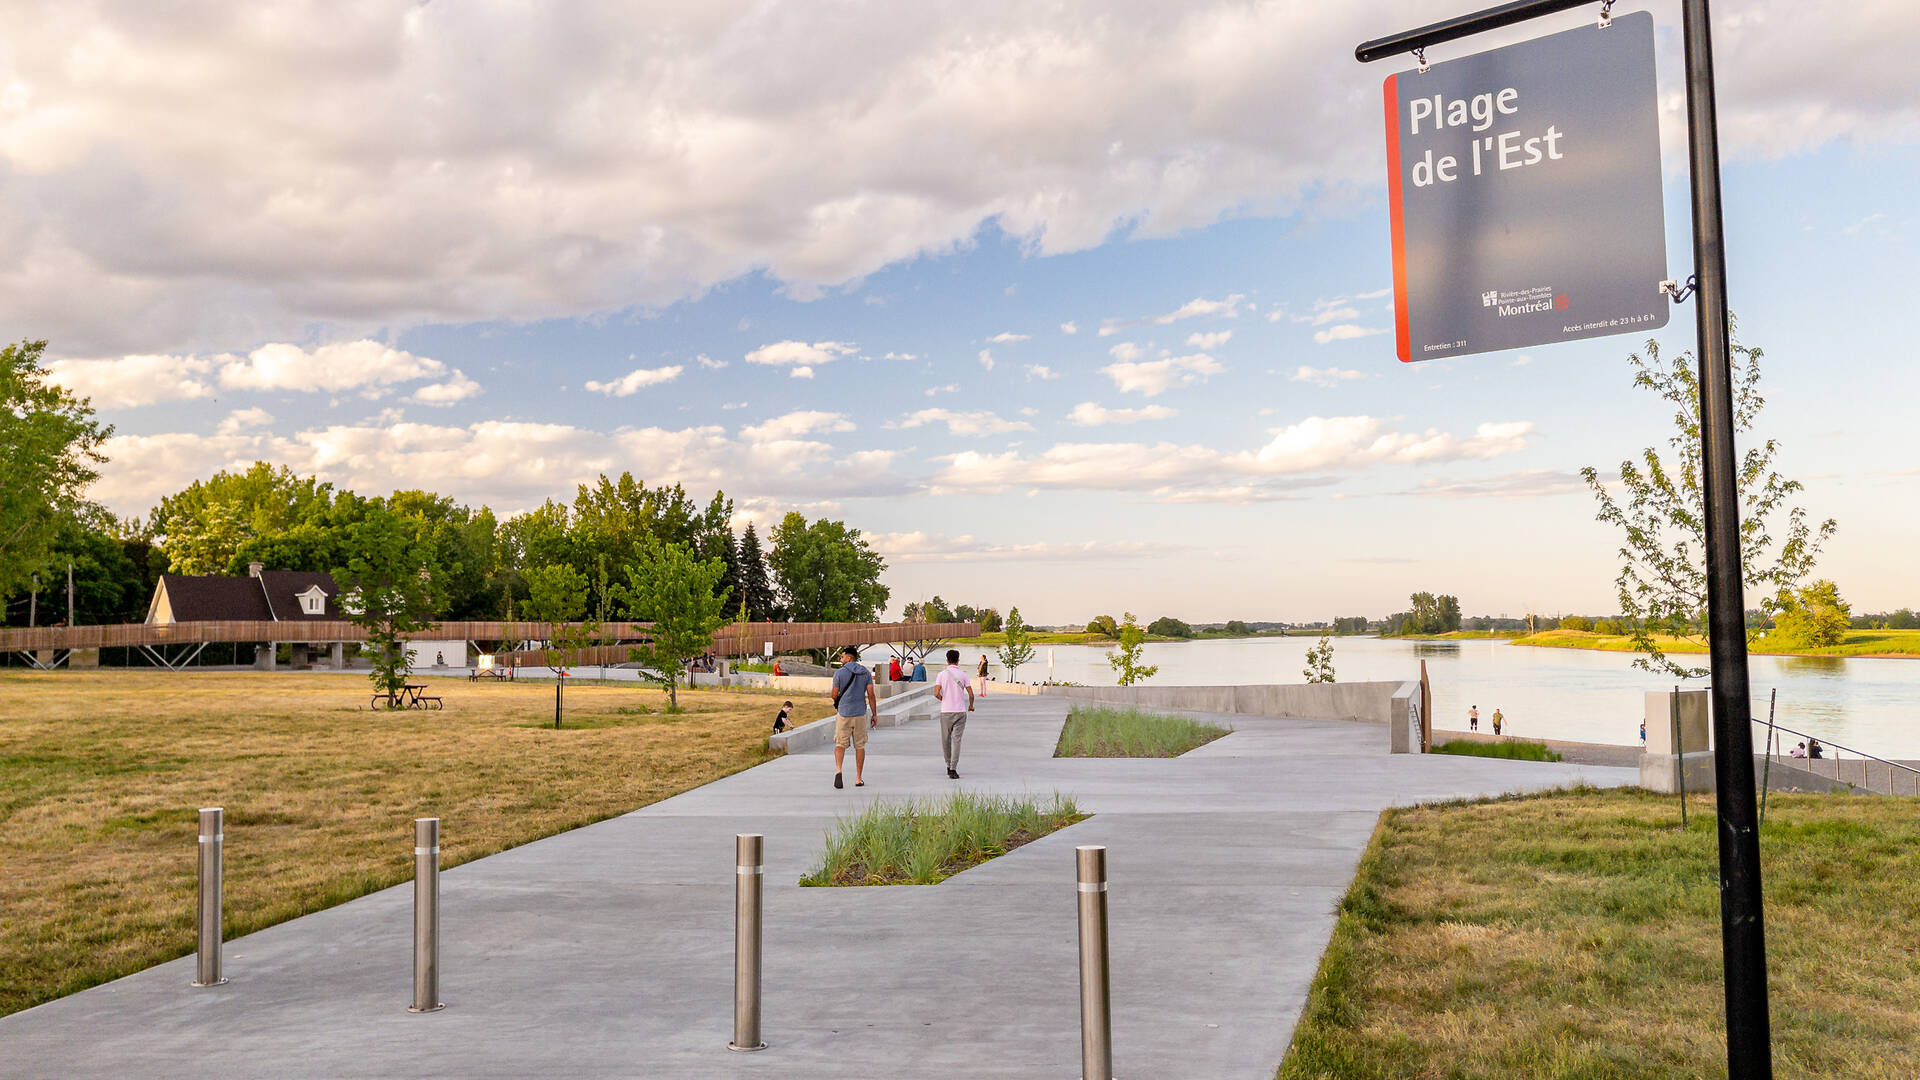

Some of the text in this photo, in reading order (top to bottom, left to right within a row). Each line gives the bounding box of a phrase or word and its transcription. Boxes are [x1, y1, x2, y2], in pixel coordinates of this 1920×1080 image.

[1410, 87, 1518, 135] Plage
[1412, 125, 1563, 187] de l'Est
[1498, 298, 1553, 317] Montréal
[1562, 324, 1582, 333] Accès
[1583, 319, 1608, 330] interdit
[1610, 319, 1619, 327] de
[1620, 317, 1629, 325] 23
[1630, 316, 1636, 324] h
[1650, 312, 1656, 320] h
[1423, 343, 1452, 352] Entretien
[1456, 340, 1467, 348] 311
